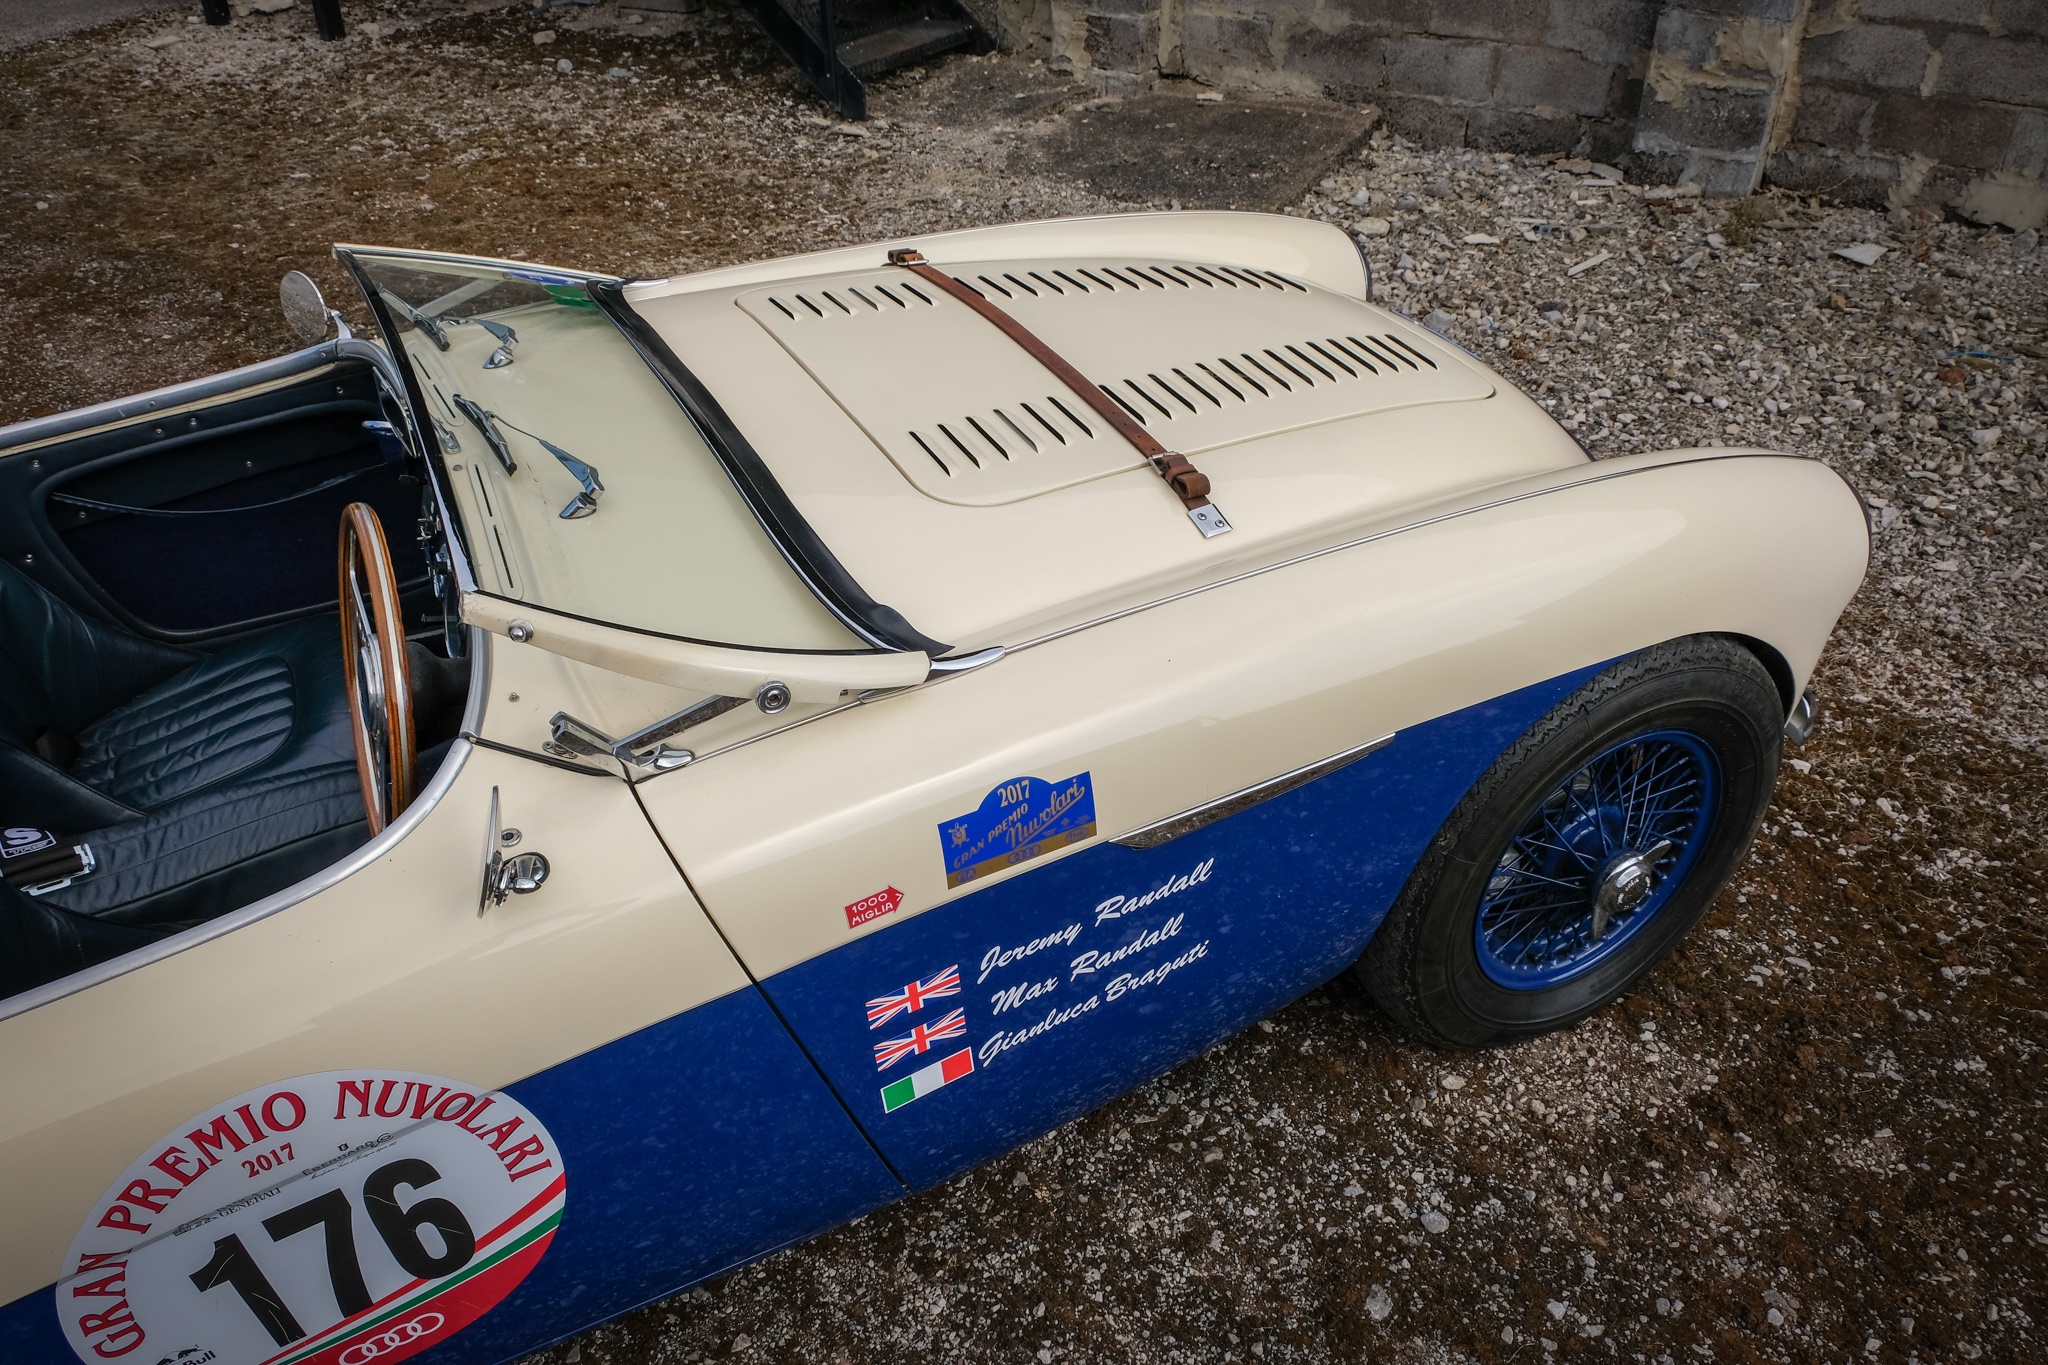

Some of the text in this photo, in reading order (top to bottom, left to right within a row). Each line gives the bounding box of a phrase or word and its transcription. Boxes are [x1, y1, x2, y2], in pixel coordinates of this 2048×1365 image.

[997, 779, 1031, 808] 2017
[1005, 778, 1086, 849] Nuvolari
[953, 802, 1029, 869] GRAN PREMIO
[851, 892, 888, 914] 1000
[852, 902, 894, 926] MIGLIA
[976, 857, 1215, 985] Jeremy Randall
[990, 912, 1185, 1017] Max Randall
[977, 939, 1210, 1068] Gianluca Braguti
[240, 1142, 297, 1179] 2017
[73, 1079, 554, 1360] GRAN PREMIO NUVOLARI
[218, 1186, 283, 1218] GENERALI
[188, 1157, 477, 1348] 176
